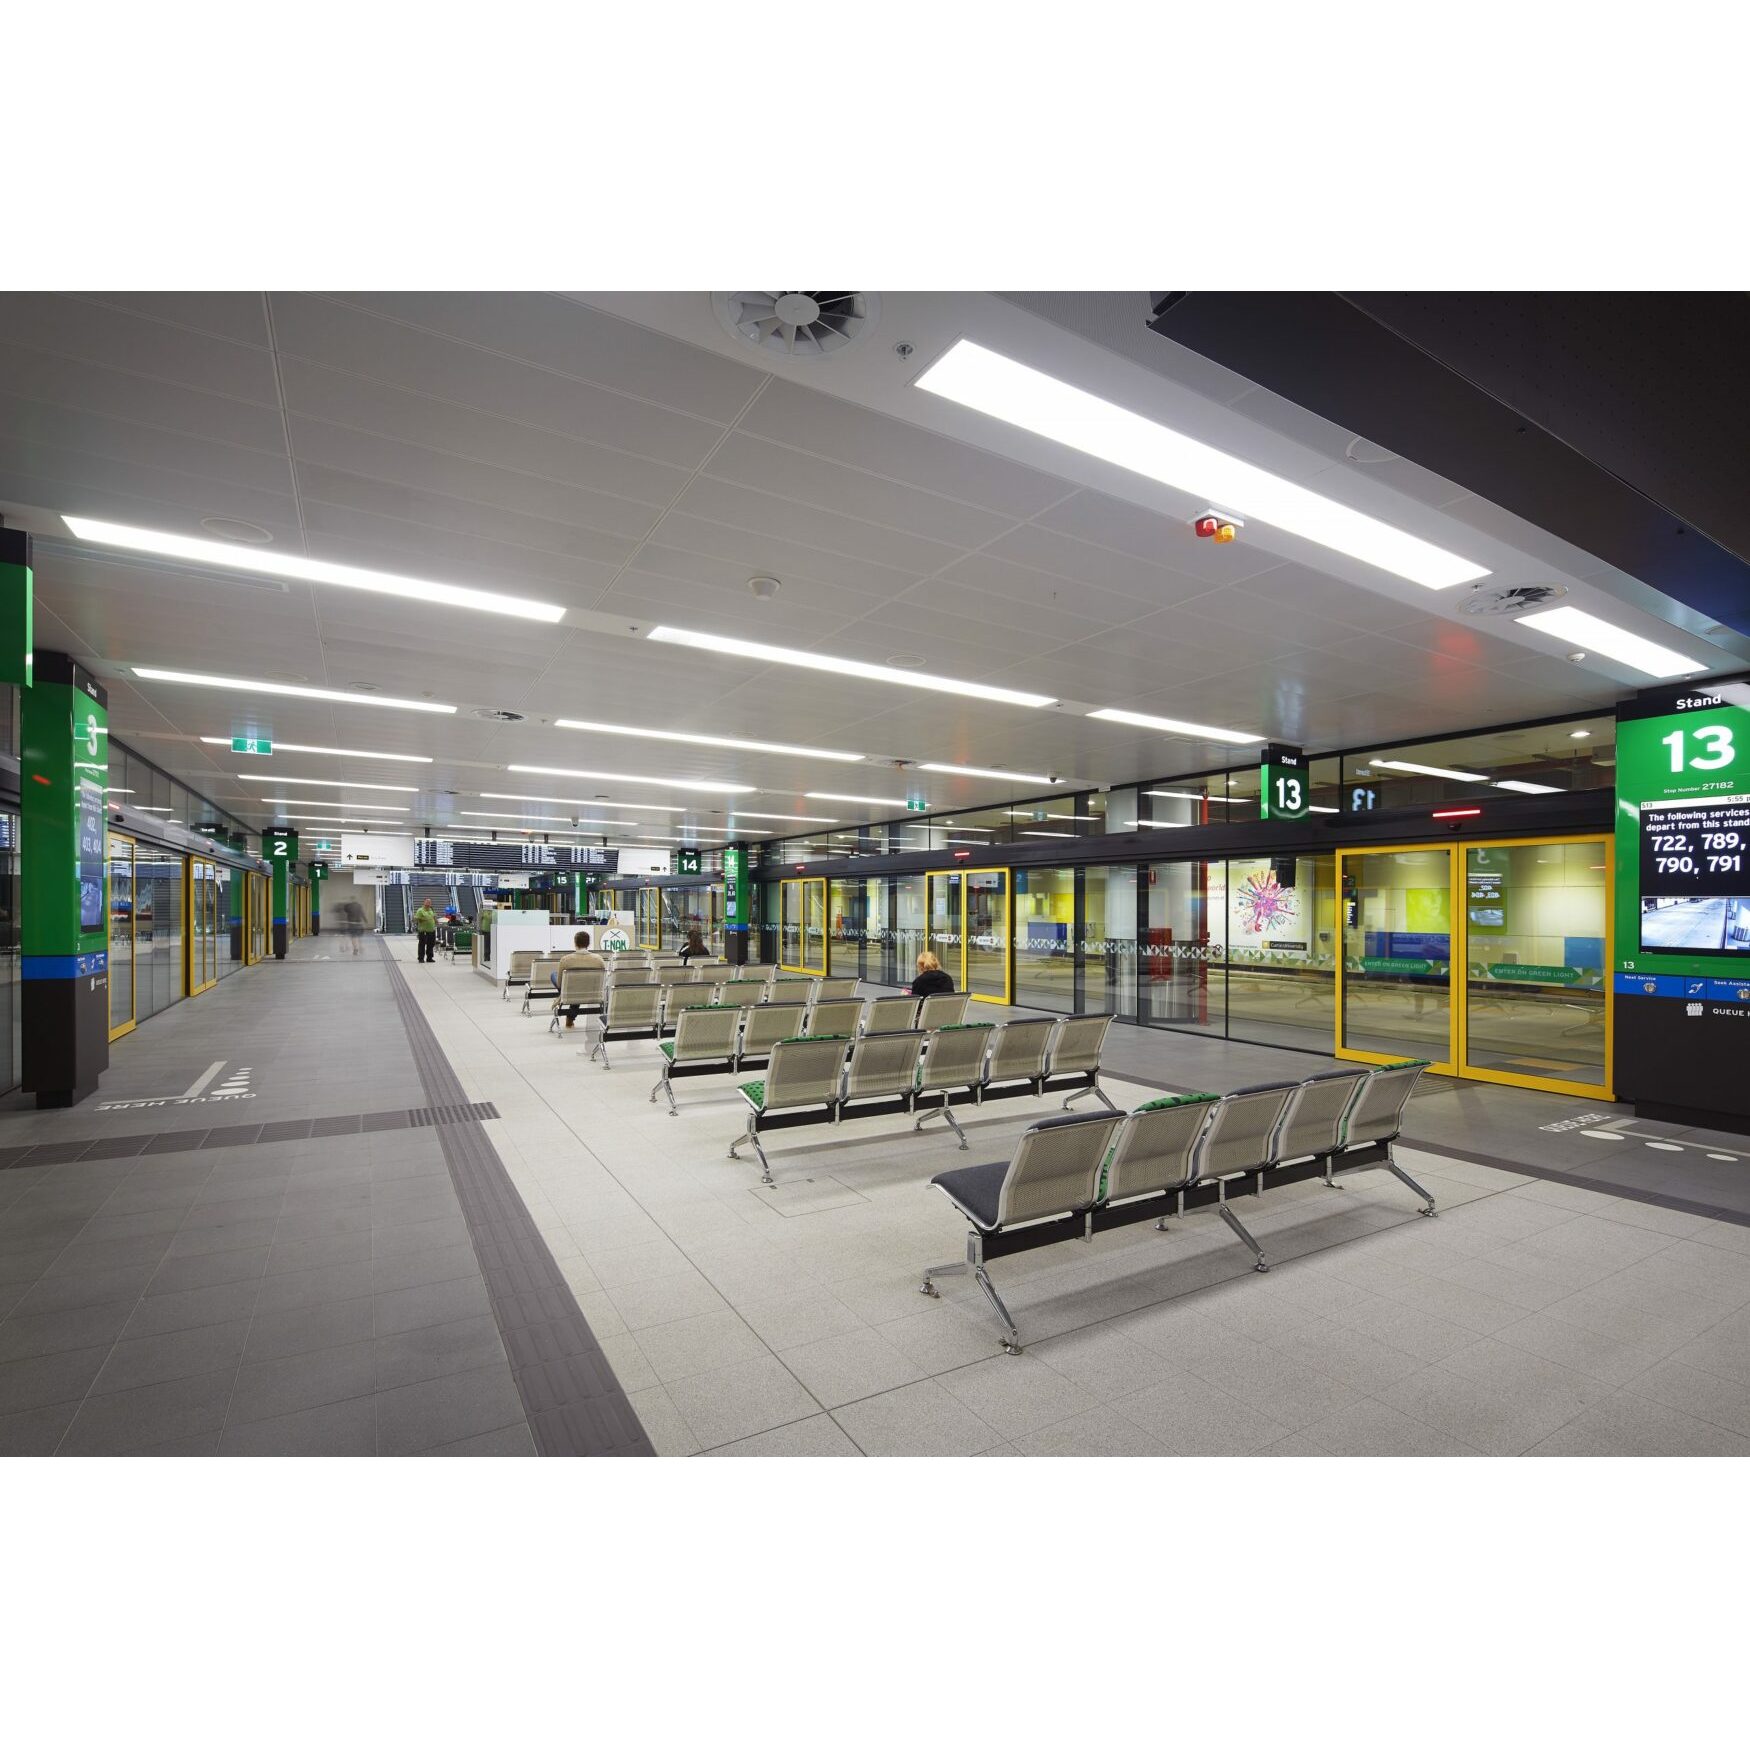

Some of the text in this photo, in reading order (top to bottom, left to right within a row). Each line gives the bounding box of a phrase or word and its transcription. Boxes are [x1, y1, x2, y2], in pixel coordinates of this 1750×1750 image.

[1676, 694, 1722, 710] Stand
[86, 714, 98, 756] 3
[1662, 725, 1736, 773] 13
[1281, 755, 1297, 766] Stand
[1702, 781, 1734, 791] 27182
[1276, 777, 1302, 811] 13
[1648, 809, 1750, 822] The following services
[1646, 818, 1750, 832] depart from this stand
[273, 841, 288, 856] 2
[1651, 832, 1747, 853] 722, 789,
[682, 859, 698, 871] 14
[1655, 855, 1741, 875] 790, 791
[315, 869, 321, 877] 1
[556, 876, 568, 884] 15
[1623, 961, 1635, 970] 13
[1712, 1008, 1745, 1017] QUEUE
[94, 1093, 257, 1112] QUEUE HERE
